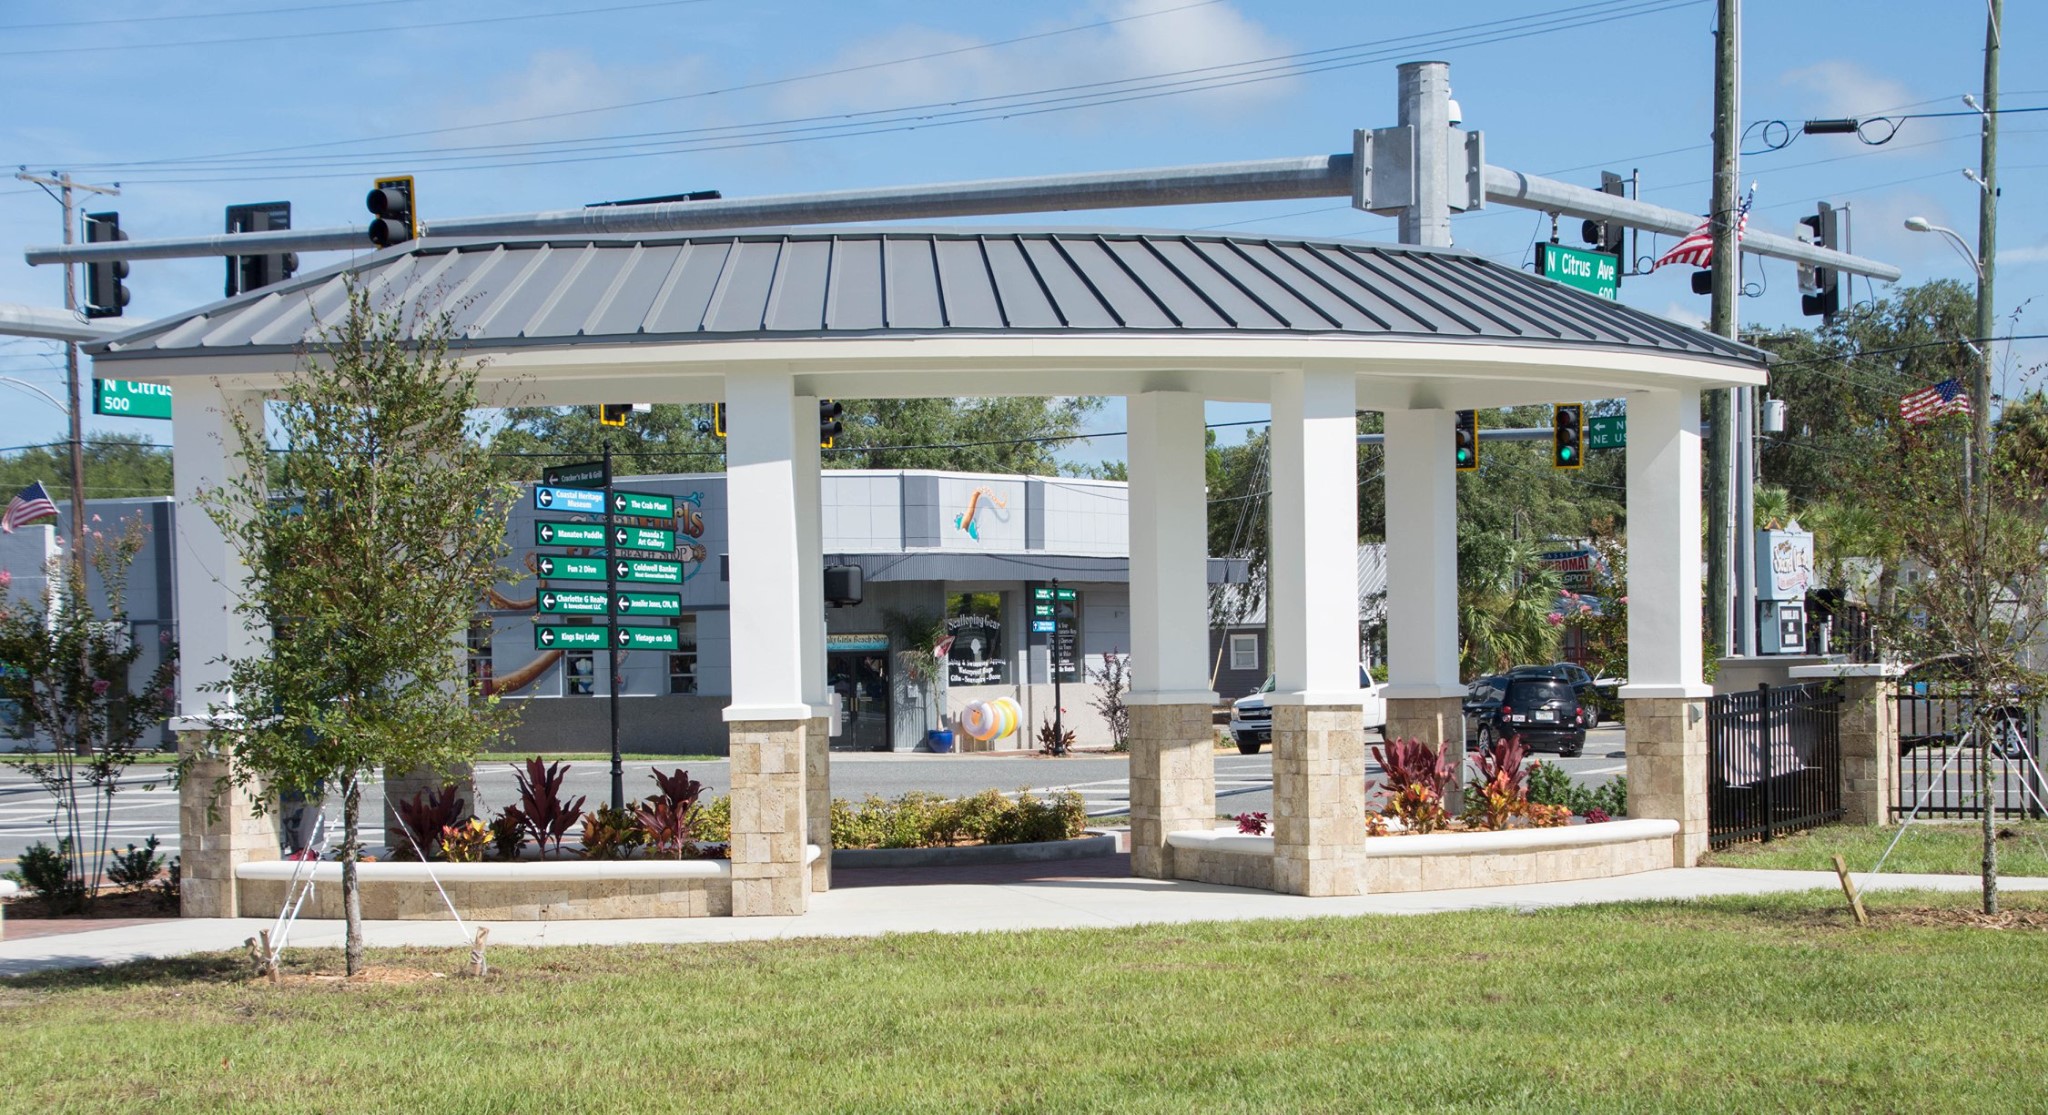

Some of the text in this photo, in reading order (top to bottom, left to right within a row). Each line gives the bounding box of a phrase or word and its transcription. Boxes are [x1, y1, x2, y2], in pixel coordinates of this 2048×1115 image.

[1547, 251, 1614, 281] N Citrus Ave
[104, 379, 117, 392] N
[104, 396, 130, 411] 500
[1593, 434, 1609, 444] NE
[556, 490, 603, 502] Coastal Heritage
[567, 500, 592, 508] Museum
[631, 500, 667, 511] The Crab Plant
[558, 530, 603, 539] Manatee Paddle
[639, 530, 659, 539] Amanda
[638, 538, 665, 549] Art Gallery
[567, 565, 578, 573] Fun
[583, 565, 597, 573] Dive
[633, 563, 678, 573] Coldwell Banker
[556, 594, 583, 603] Charlotte
[590, 596, 608, 605] Realty
[949, 614, 1001, 630] Scalloping Gear
[561, 633, 600, 642] Kings Bay Lodge
[635, 633, 655, 643] Vintage
[663, 634, 672, 642] 5th
